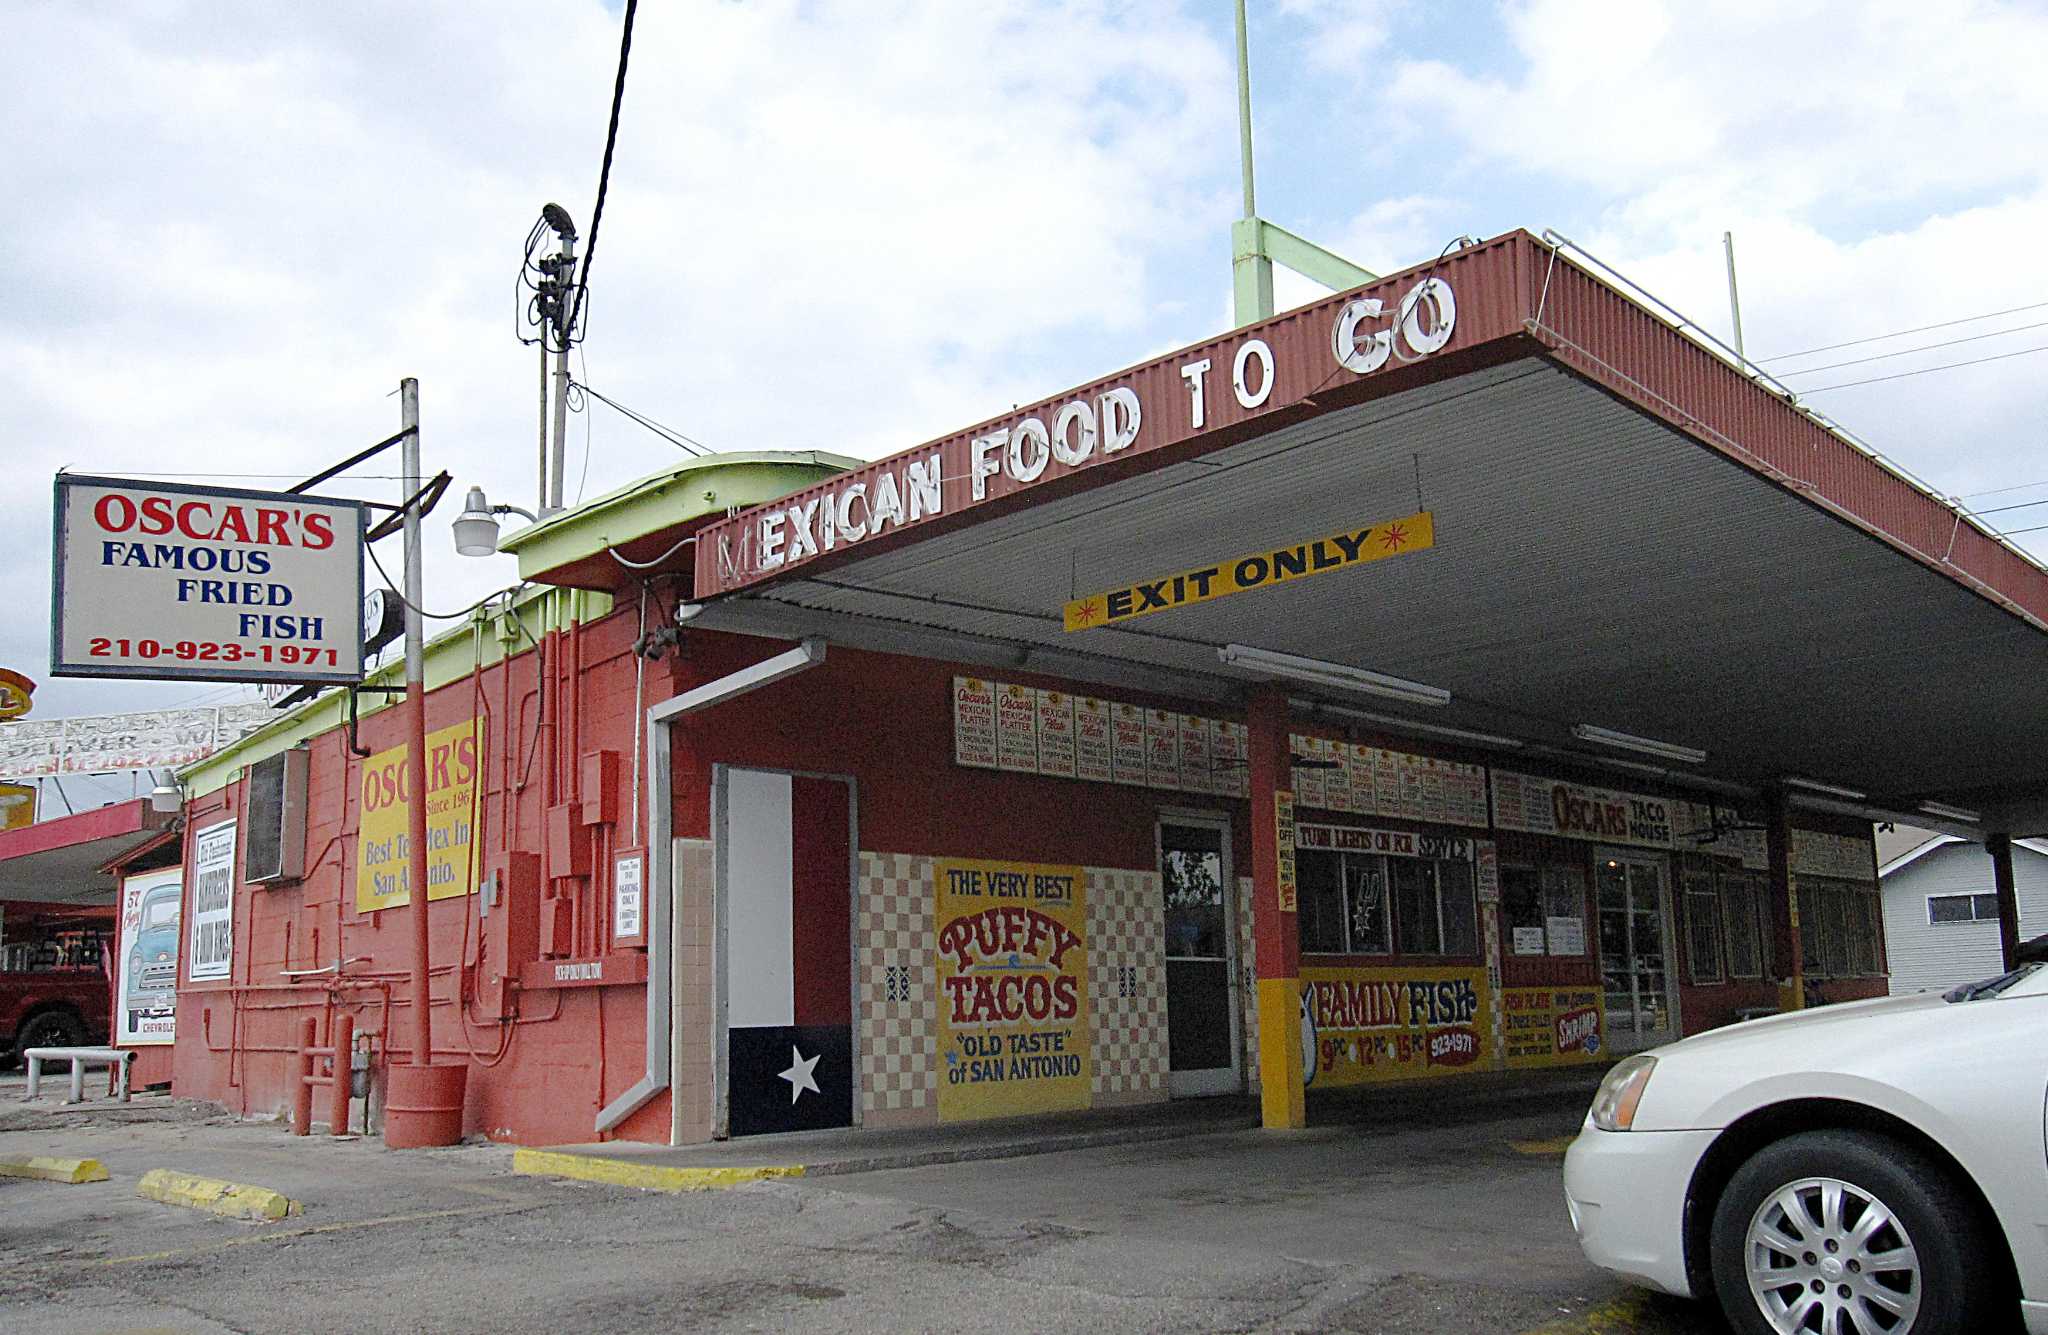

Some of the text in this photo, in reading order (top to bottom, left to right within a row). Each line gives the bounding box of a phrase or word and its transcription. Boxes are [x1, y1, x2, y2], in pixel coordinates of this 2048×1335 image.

[717, 277, 1457, 582] MEXICAN FOOD TO GO
[94, 494, 334, 550] OSCAR'S
[101, 541, 271, 574] FAMOUS
[1107, 529, 1374, 621] EXIT ONLY
[176, 579, 293, 607] FRIED
[239, 614, 324, 641] FISH
[90, 638, 337, 666] 210-923-1971
[960, 704, 991, 717] MEXICAN
[960, 714, 990, 726] PLATTER
[1000, 710, 1032, 722] MEXICAN
[1040, 707, 1070, 719] MEXICAN
[1001, 719, 1031, 732] PLATTER
[364, 736, 476, 812] OSCR'S
[1631, 799, 1665, 822] TACO
[455, 820, 468, 844] In
[1300, 826, 1331, 846] TURN
[1335, 829, 1371, 849] LIGHTS
[1376, 832, 1390, 850] ON
[1393, 833, 1413, 853] FOR
[1631, 820, 1669, 841] HOUSE
[366, 836, 391, 865] Best
[374, 870, 395, 896] San
[947, 870, 1074, 900] THE VERY BEST
[937, 906, 1082, 972] PUFFY
[944, 975, 1078, 1024] TACOS
[1313, 980, 1477, 1028] FAMILY FISH
[1558, 1011, 1598, 1050] SHRIMP
[1431, 1033, 1474, 1058] 923-1971
[949, 1053, 1081, 1085] of SAN ANTONIO
